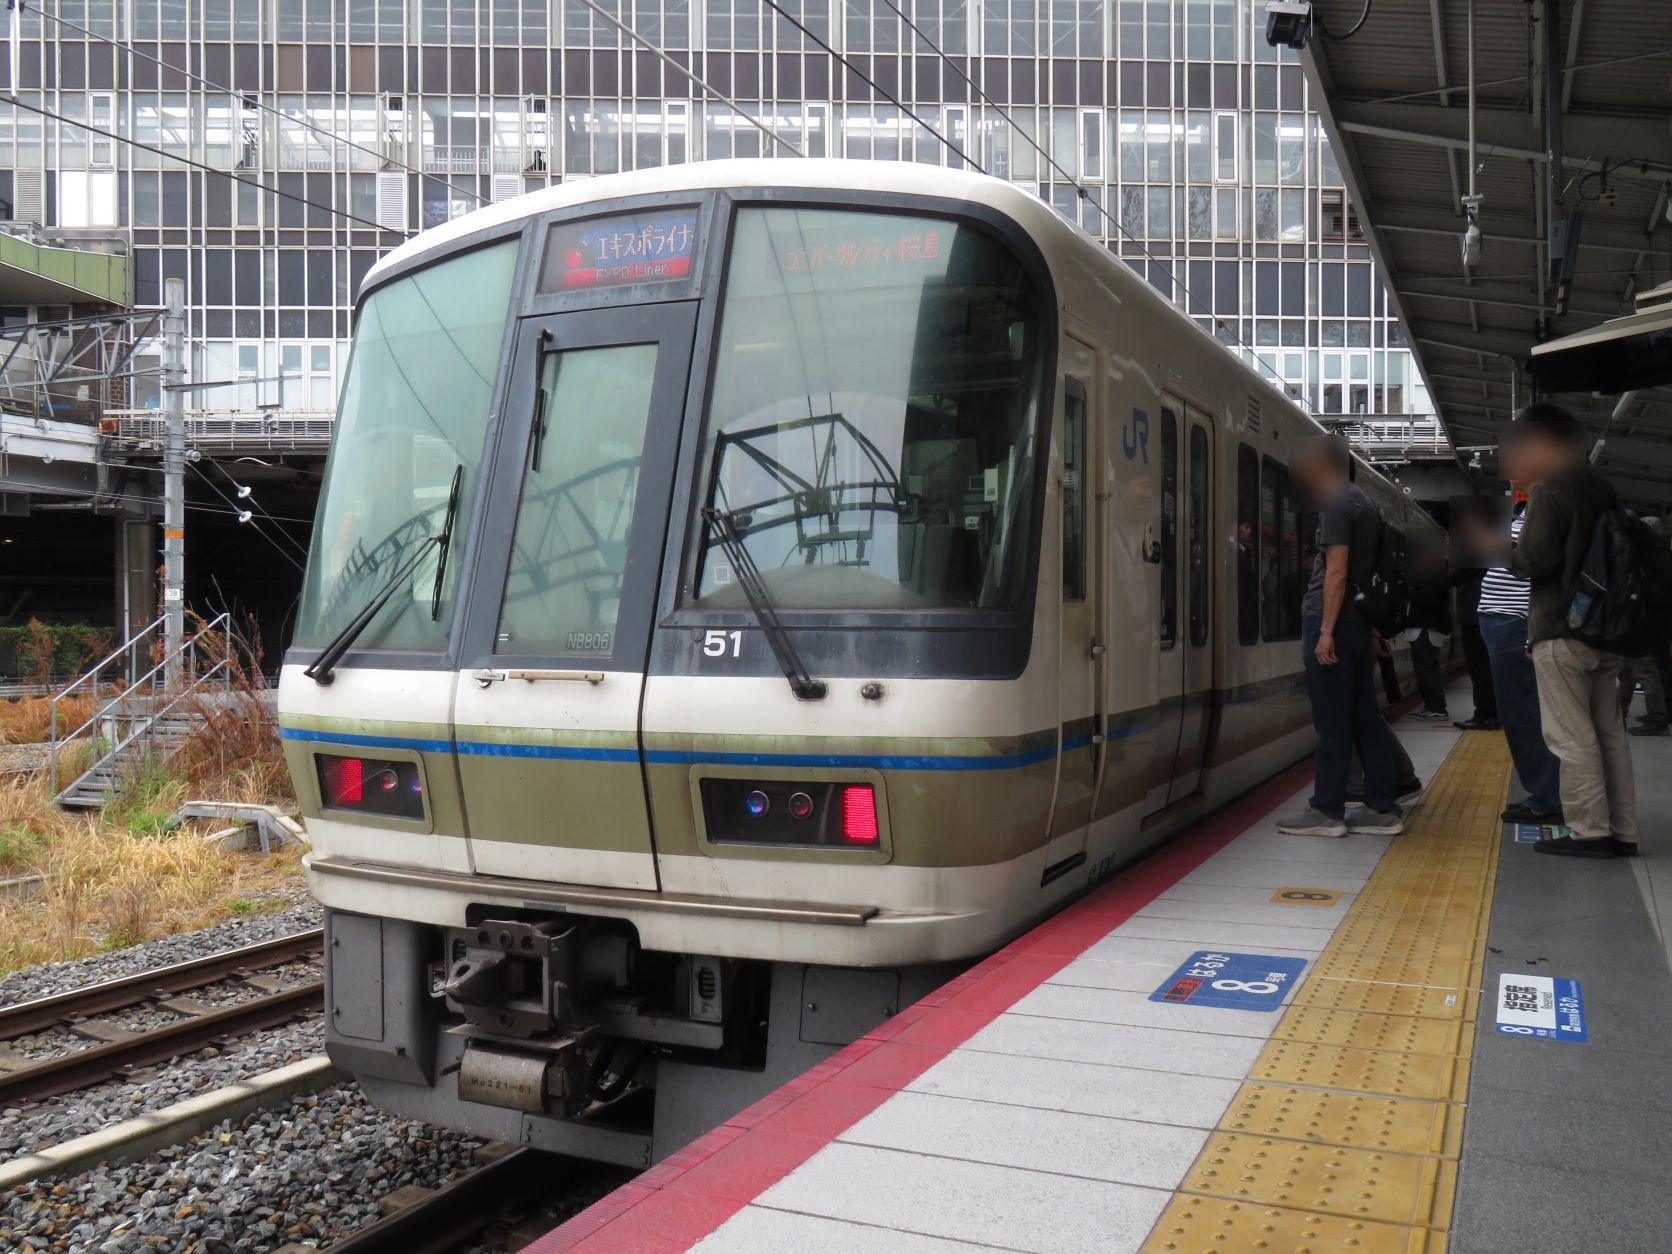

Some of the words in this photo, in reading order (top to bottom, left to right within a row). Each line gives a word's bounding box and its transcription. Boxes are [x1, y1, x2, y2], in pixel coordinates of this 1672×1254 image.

[597, 224, 694, 260] エキスポライナ
[635, 264, 667, 278] Liner
[1122, 407, 1150, 465] JR
[567, 632, 611, 650] NB806
[703, 630, 742, 658] 51
[1281, 891, 1333, 901] 8
[1185, 953, 1231, 978] はるか
[1503, 984, 1539, 1013] 指定席
[1559, 996, 1579, 1014] はるか
